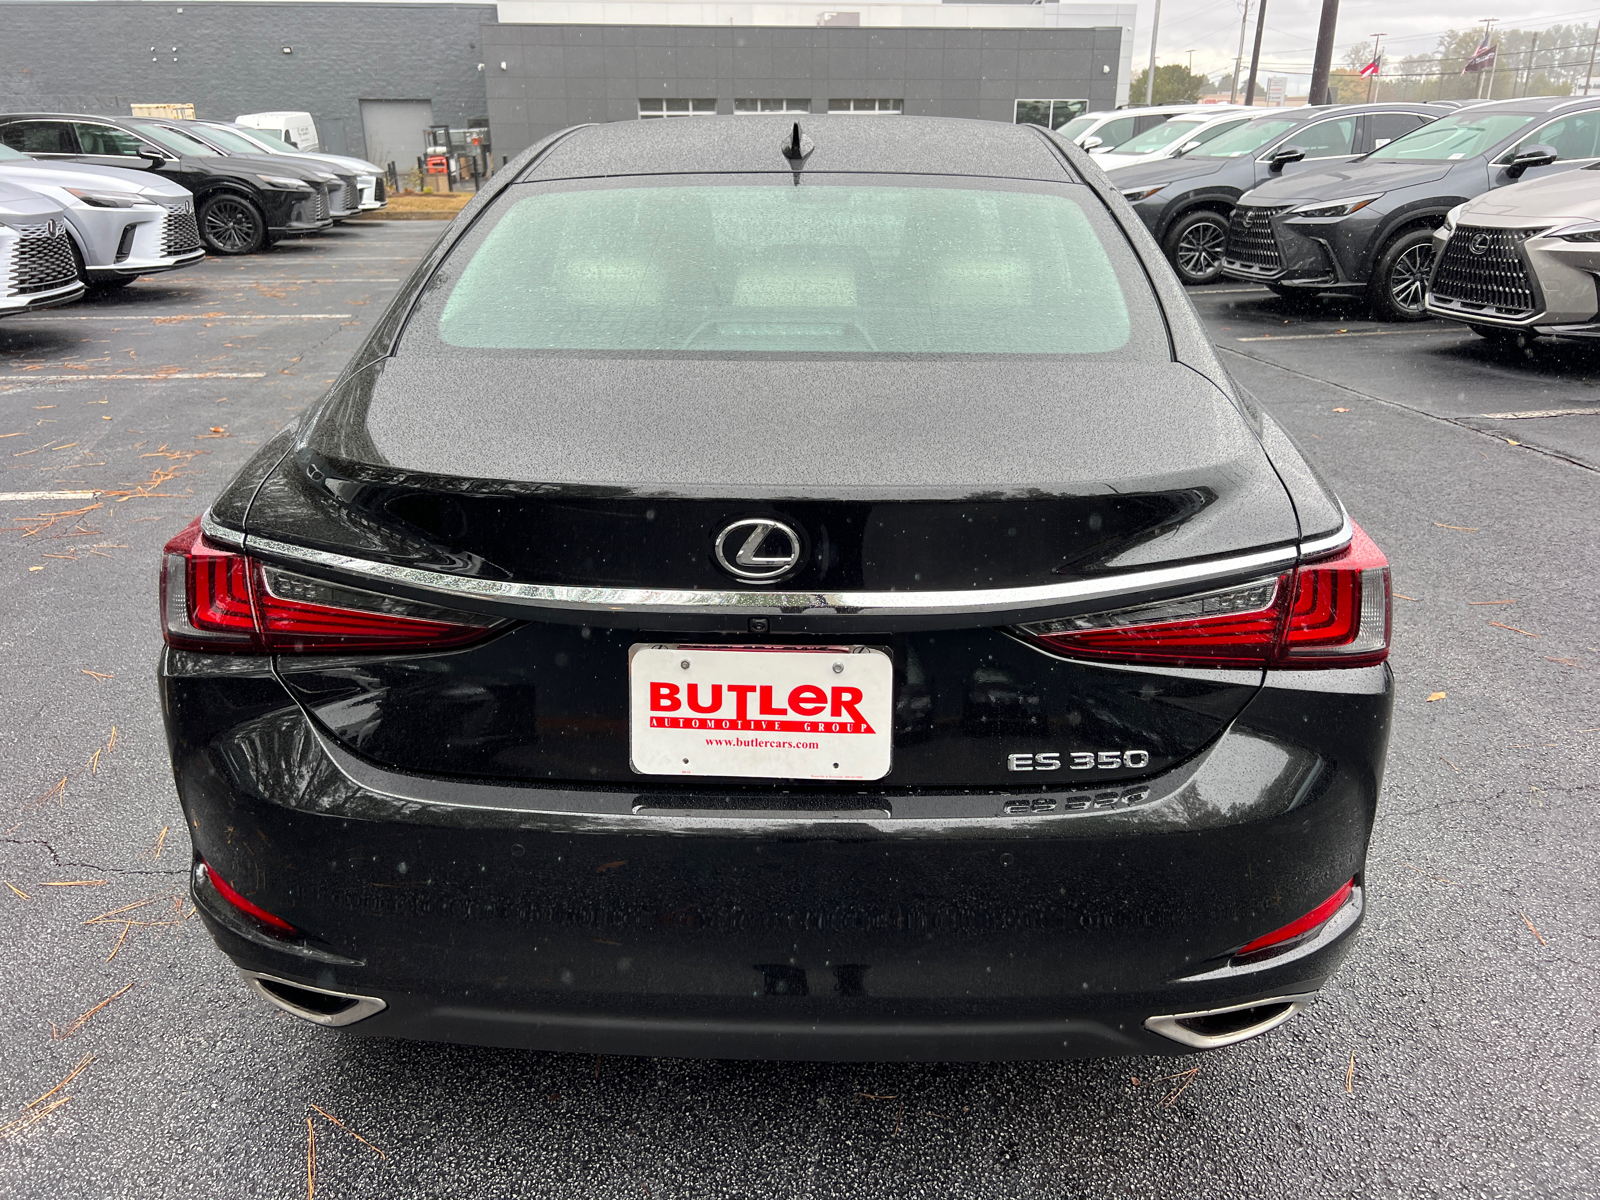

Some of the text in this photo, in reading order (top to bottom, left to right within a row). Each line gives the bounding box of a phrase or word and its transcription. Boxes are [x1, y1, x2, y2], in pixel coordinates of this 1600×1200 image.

[651, 717, 868, 733] AUTOMOTIVE GROUP
[705, 737, 819, 750] www.butlercars.com
[1007, 750, 1149, 772] ES 350
